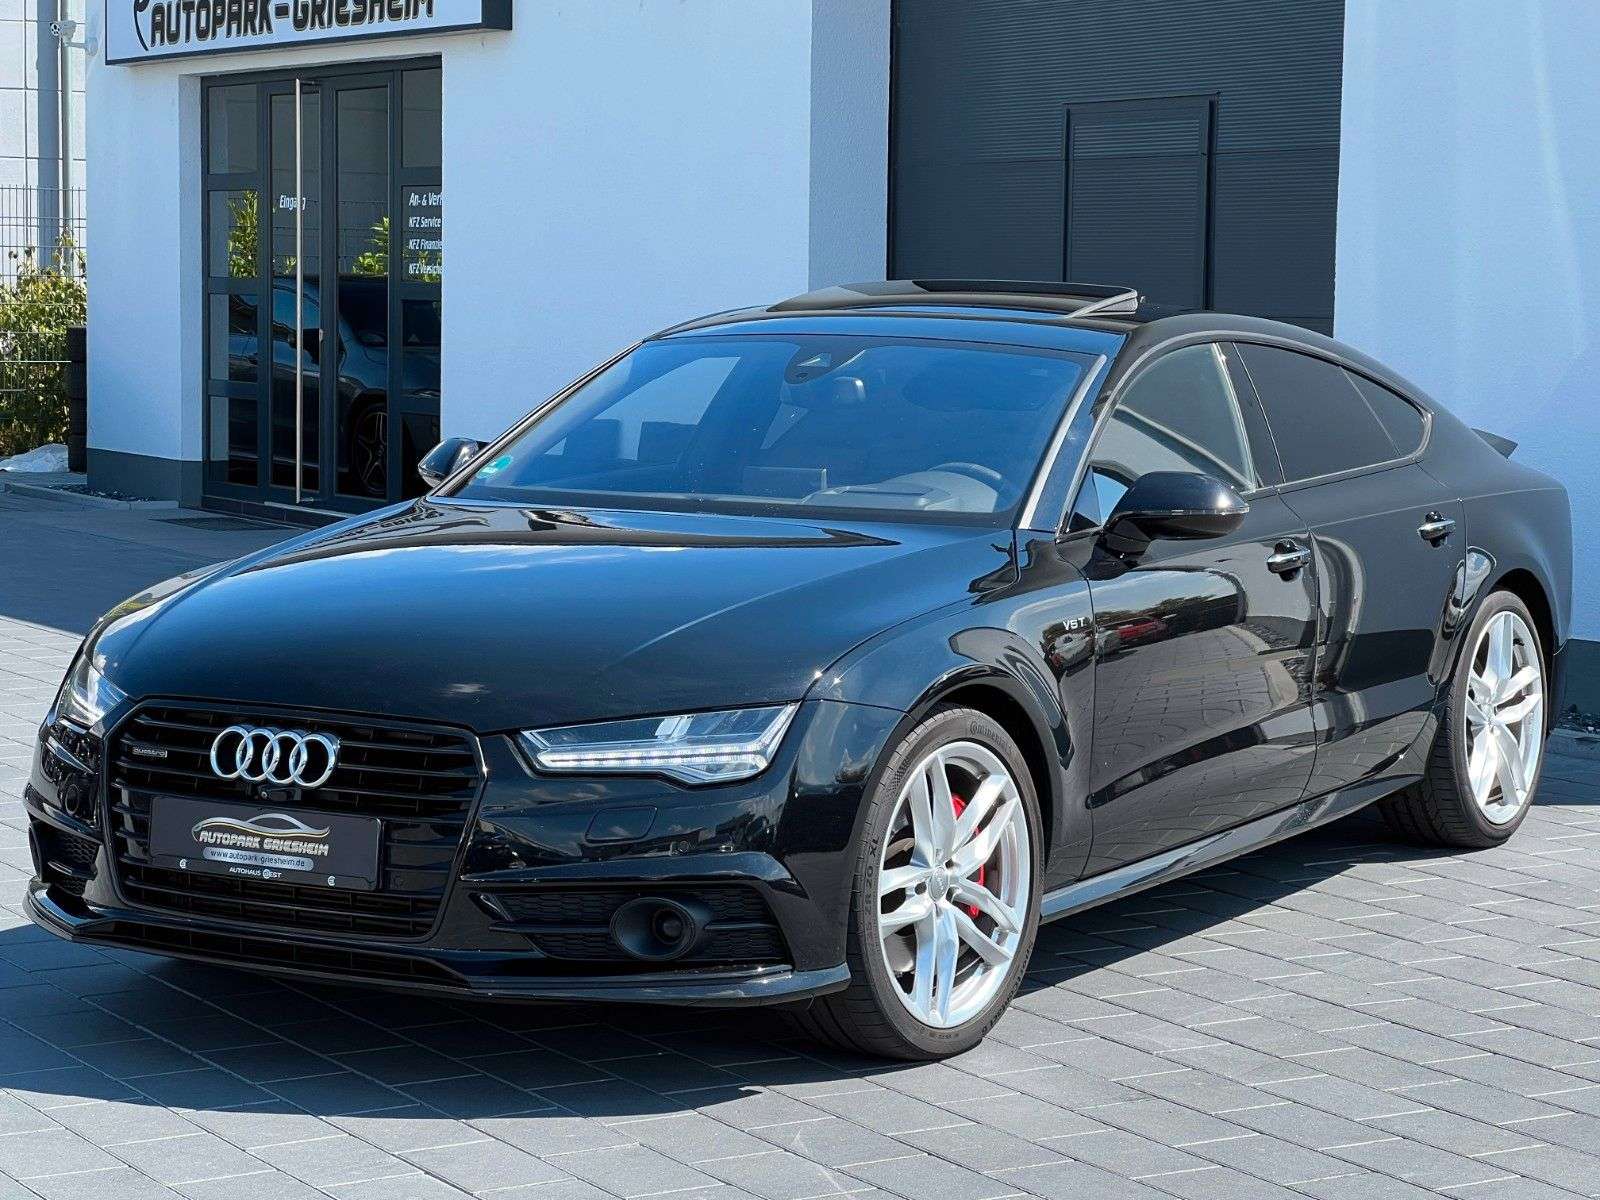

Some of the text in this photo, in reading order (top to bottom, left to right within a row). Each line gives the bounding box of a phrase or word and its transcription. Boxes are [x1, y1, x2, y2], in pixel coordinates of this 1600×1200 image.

[279, 194, 306, 210] Eingag
[408, 192, 421, 206] An-
[421, 194, 427, 206] &
[408, 216, 442, 228] KFZ Service
[408, 239, 420, 250] KFZ
[408, 263, 420, 273] KFZ
[199, 830, 330, 857] AUTOPARK GRIESHEIM
[209, 849, 306, 868] www.autopark-griesheim.de
[229, 866, 261, 876] AUTOHAUS
